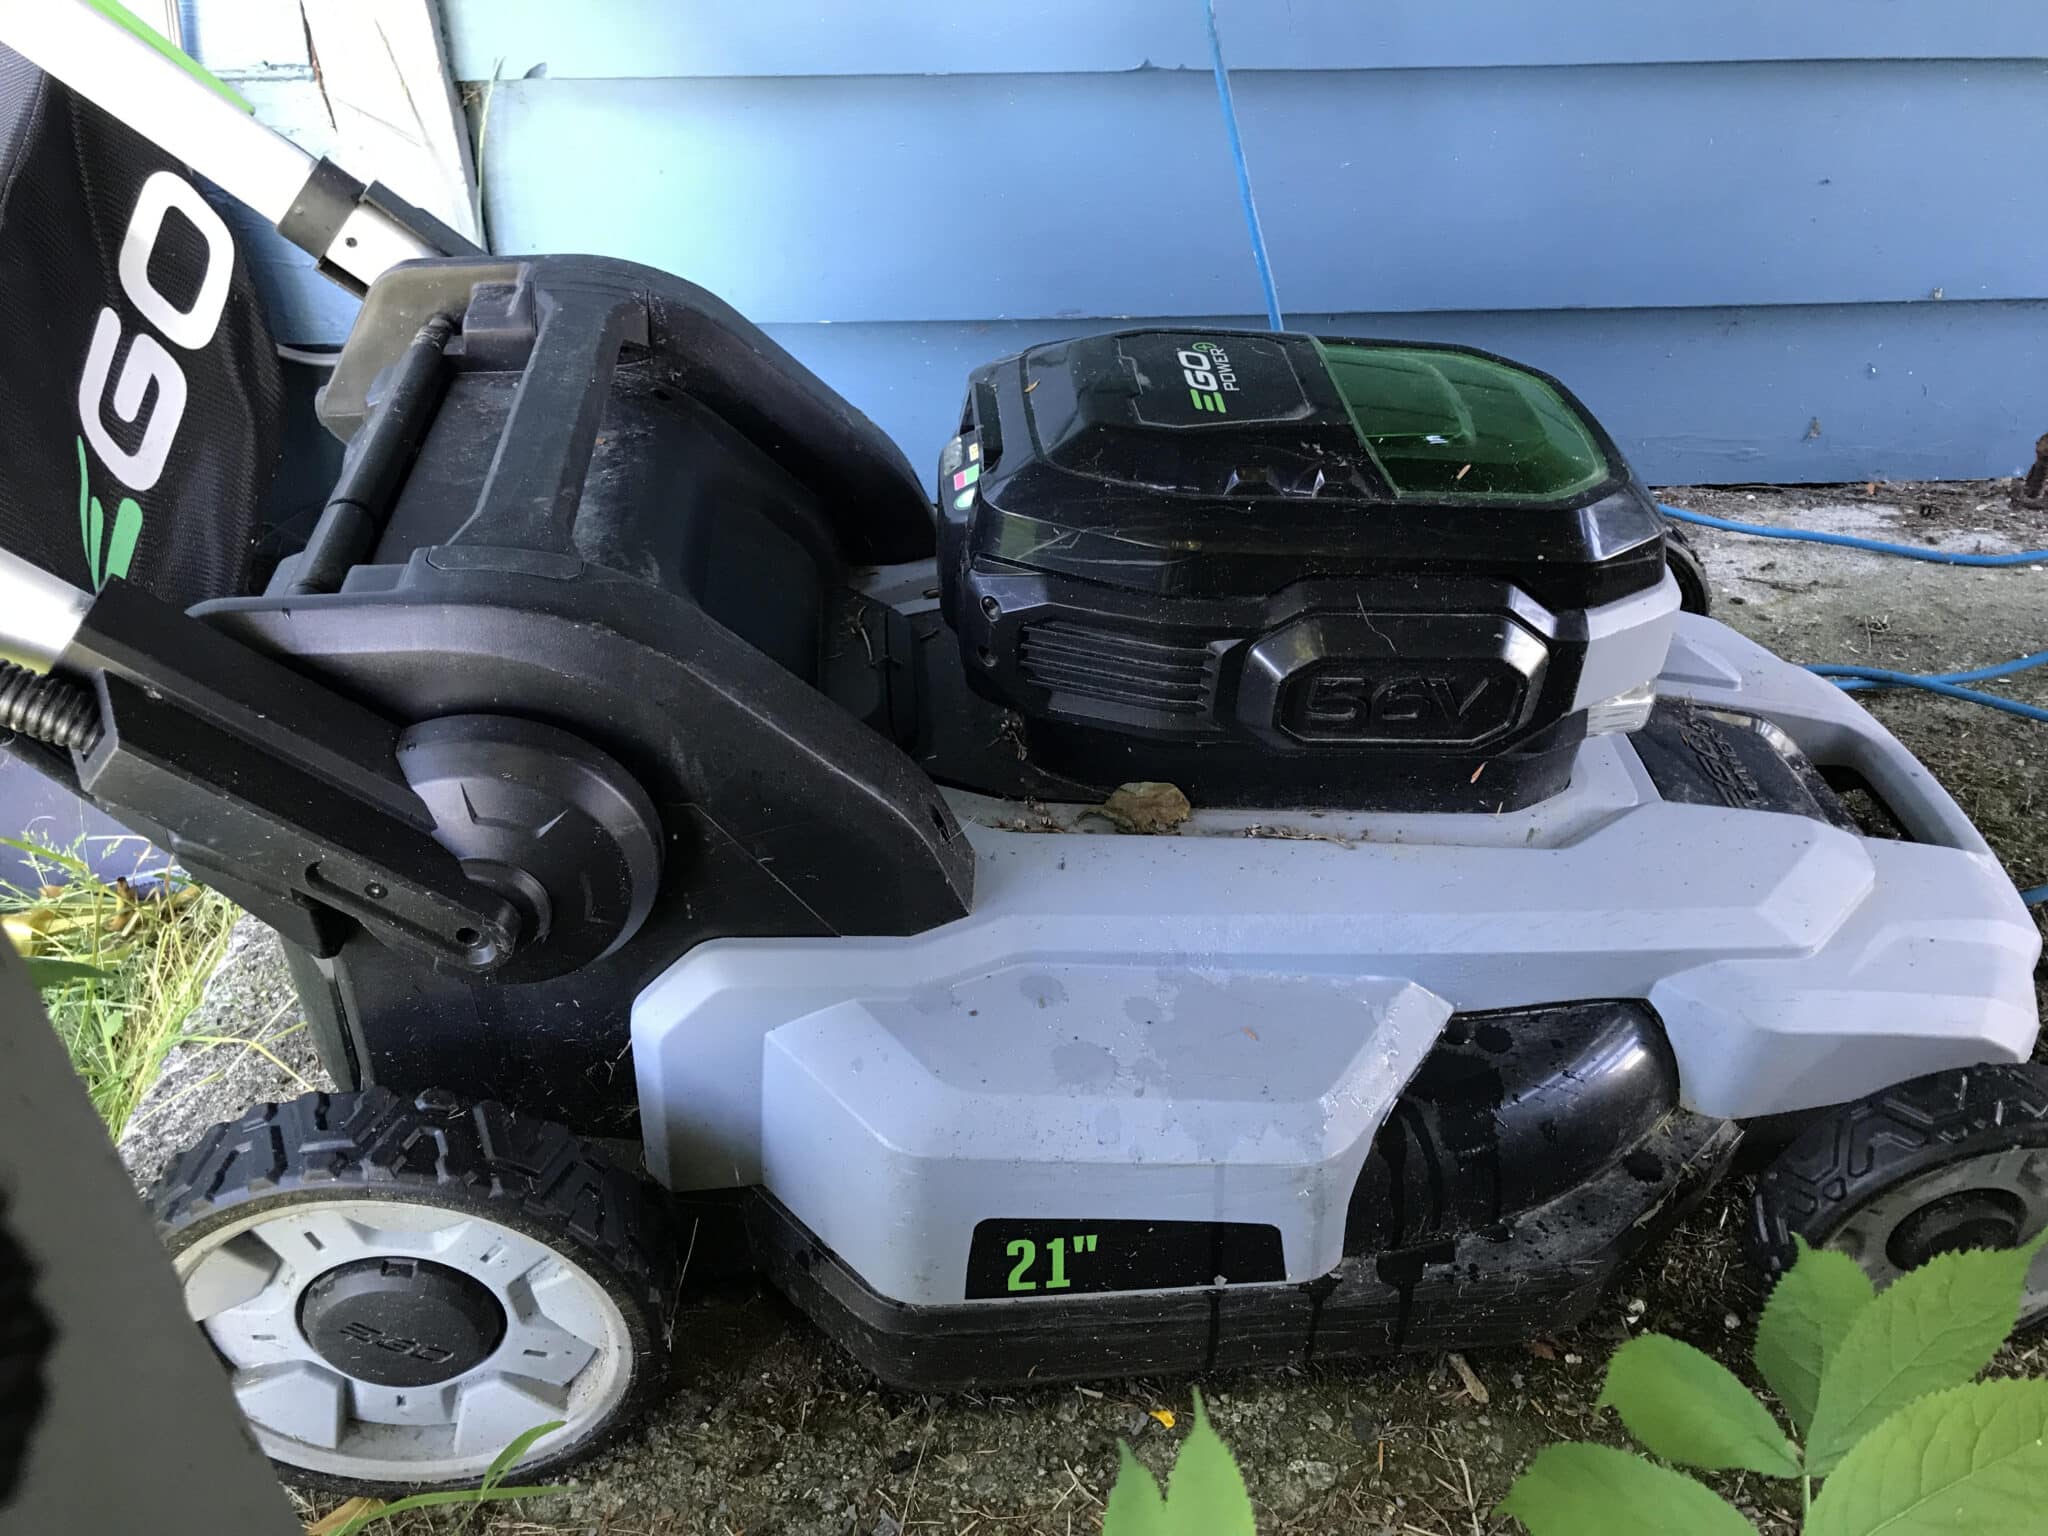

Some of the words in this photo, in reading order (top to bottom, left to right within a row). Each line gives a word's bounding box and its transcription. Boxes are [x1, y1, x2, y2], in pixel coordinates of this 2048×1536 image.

[1177, 349, 1226, 413] EGO
[1209, 347, 1240, 391] POWER
[1305, 677, 1490, 723] 56V
[1006, 1234, 1098, 1291] 21"
